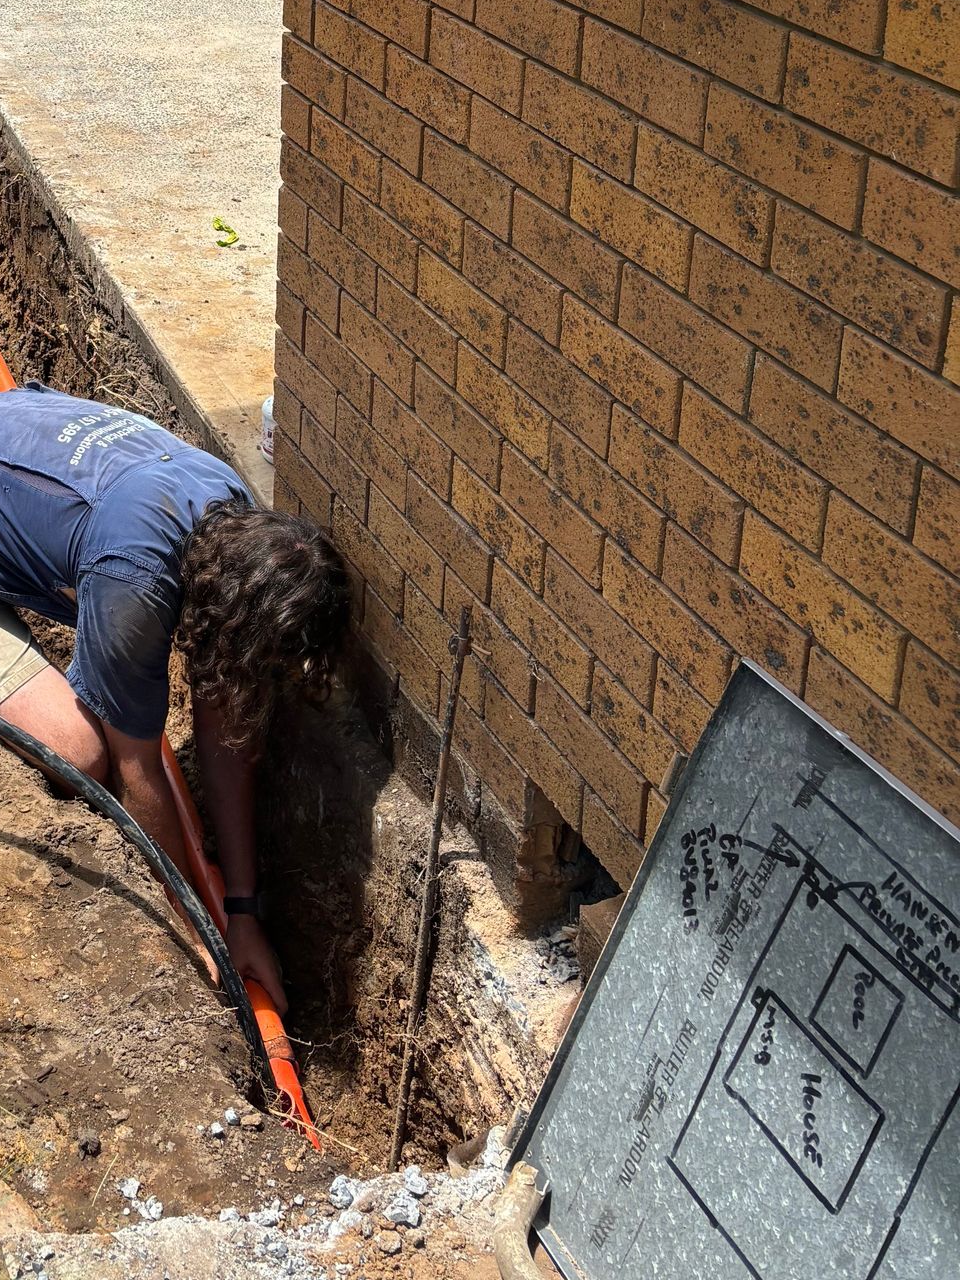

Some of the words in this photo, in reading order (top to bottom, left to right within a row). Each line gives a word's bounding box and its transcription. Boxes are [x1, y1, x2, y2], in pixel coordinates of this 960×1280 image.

[57, 422, 82, 444] 595
[78, 415, 102, 426] 157
[106, 424, 145, 444] Electrical
[70, 418, 134, 466] Communications
[852, 971, 875, 1030] POOL
[662, 1018, 698, 1087] BUTLER
